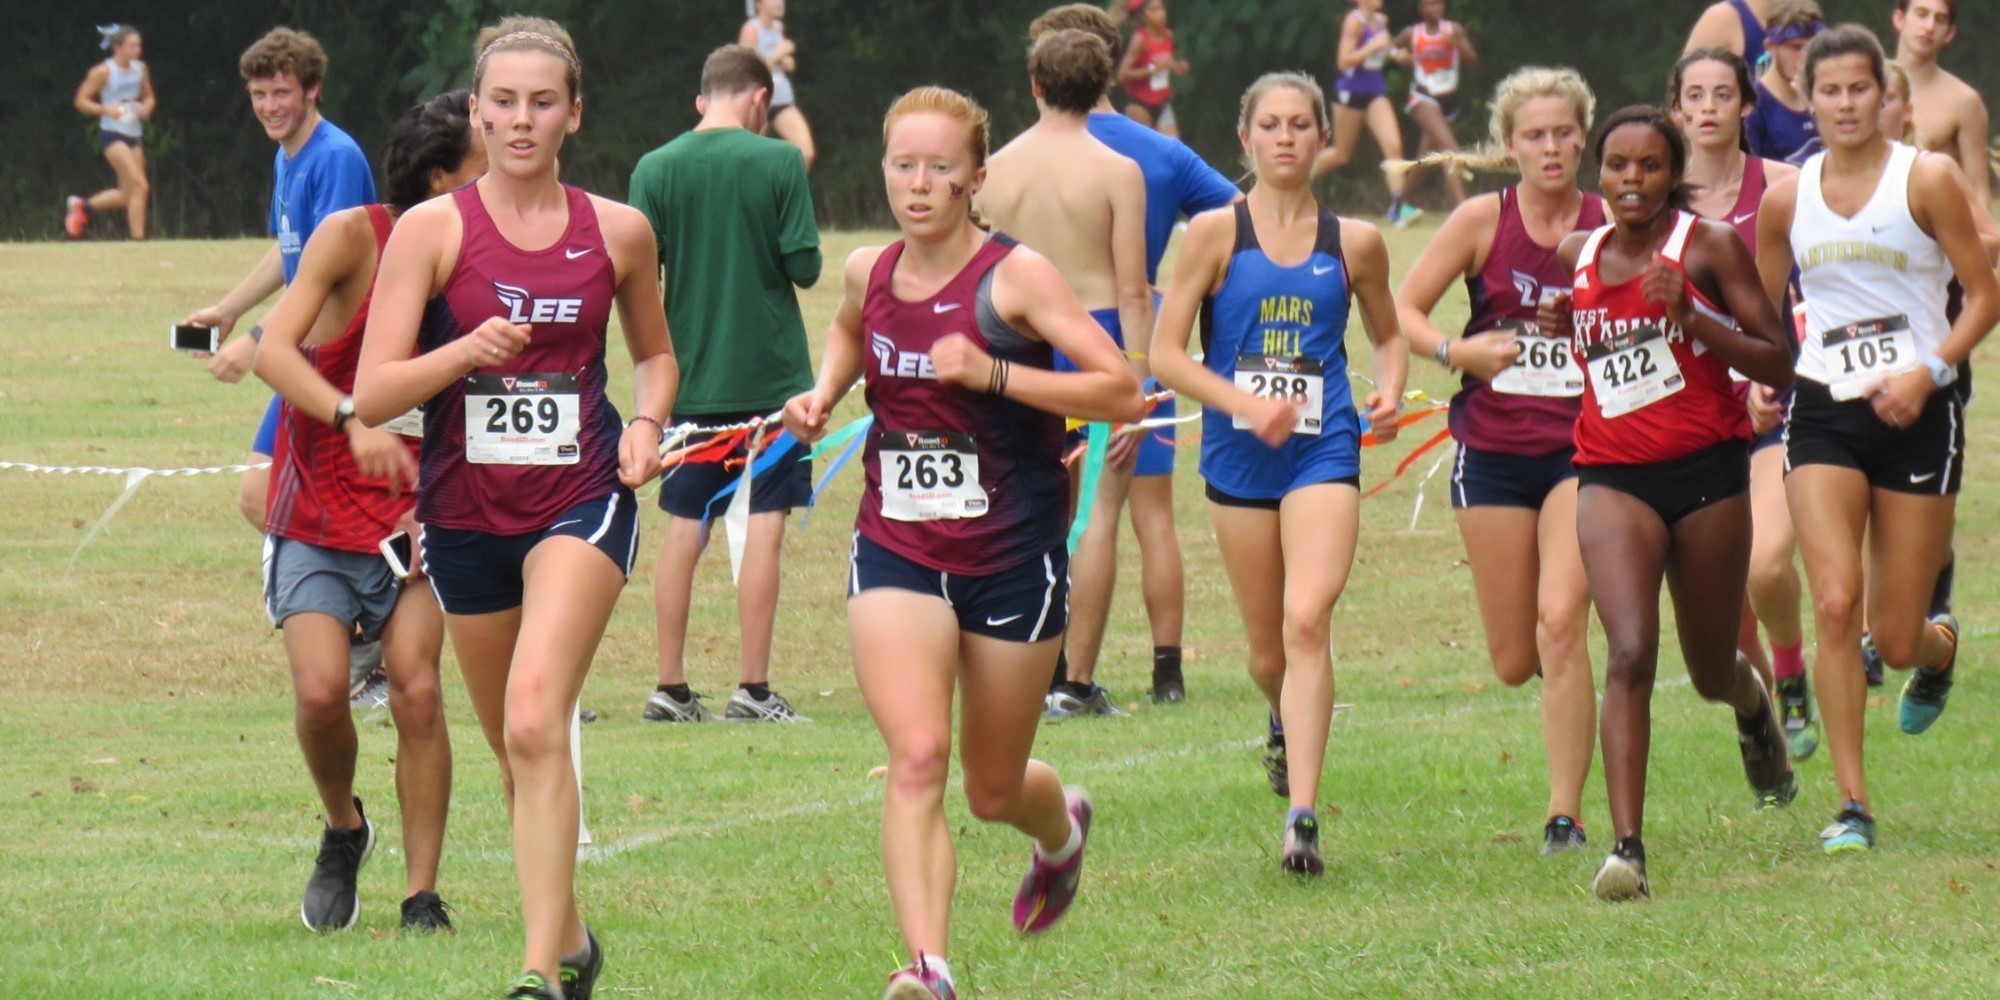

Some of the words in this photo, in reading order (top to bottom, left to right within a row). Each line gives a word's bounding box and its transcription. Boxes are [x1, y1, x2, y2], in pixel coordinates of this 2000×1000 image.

[1260, 296, 1313, 327] MARS
[1263, 329, 1303, 357] HILL
[1514, 341, 1568, 369] 266
[1840, 337, 1899, 374] 105
[880, 350, 937, 379] LEE
[1603, 347, 1658, 389] 422
[1251, 374, 1308, 406] 288
[486, 397, 560, 434] 269
[896, 453, 964, 490] 263
